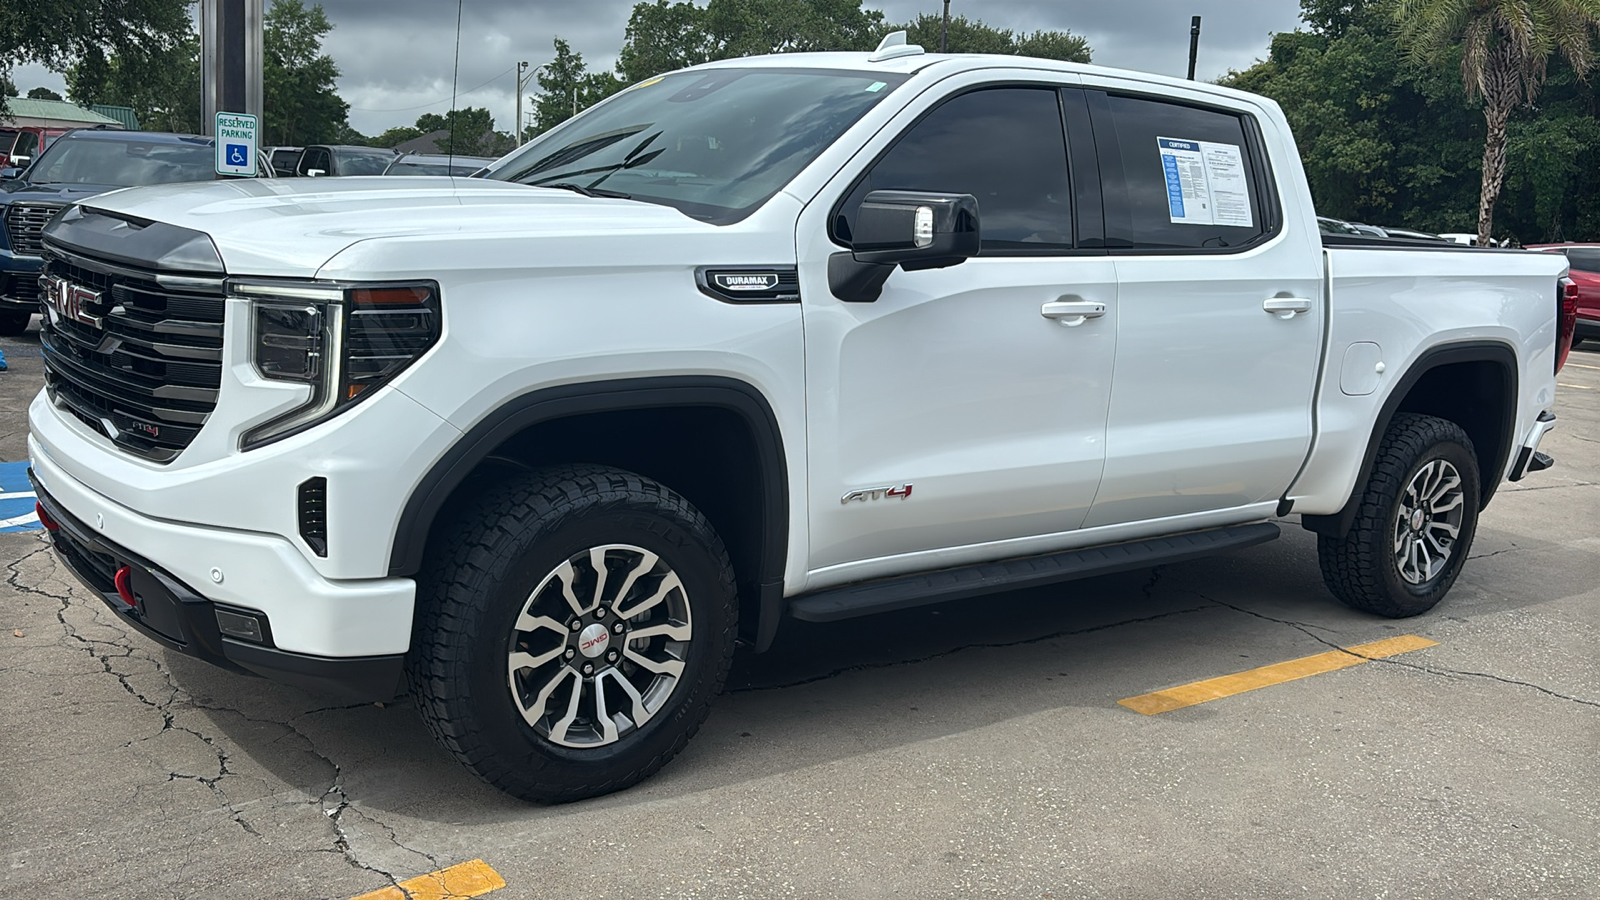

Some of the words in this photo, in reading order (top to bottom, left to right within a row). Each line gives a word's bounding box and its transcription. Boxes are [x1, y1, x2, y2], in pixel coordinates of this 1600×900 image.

[219, 118, 255, 129] RESERVED
[221, 129, 253, 139] PARKING
[1168, 141, 1191, 149] CERTIFIED
[726, 276, 768, 285] DURAMAX
[38, 274, 103, 330] GMC
[131, 421, 159, 438] AT4
[840, 482, 914, 505] AT4
[581, 632, 608, 650] GMC
